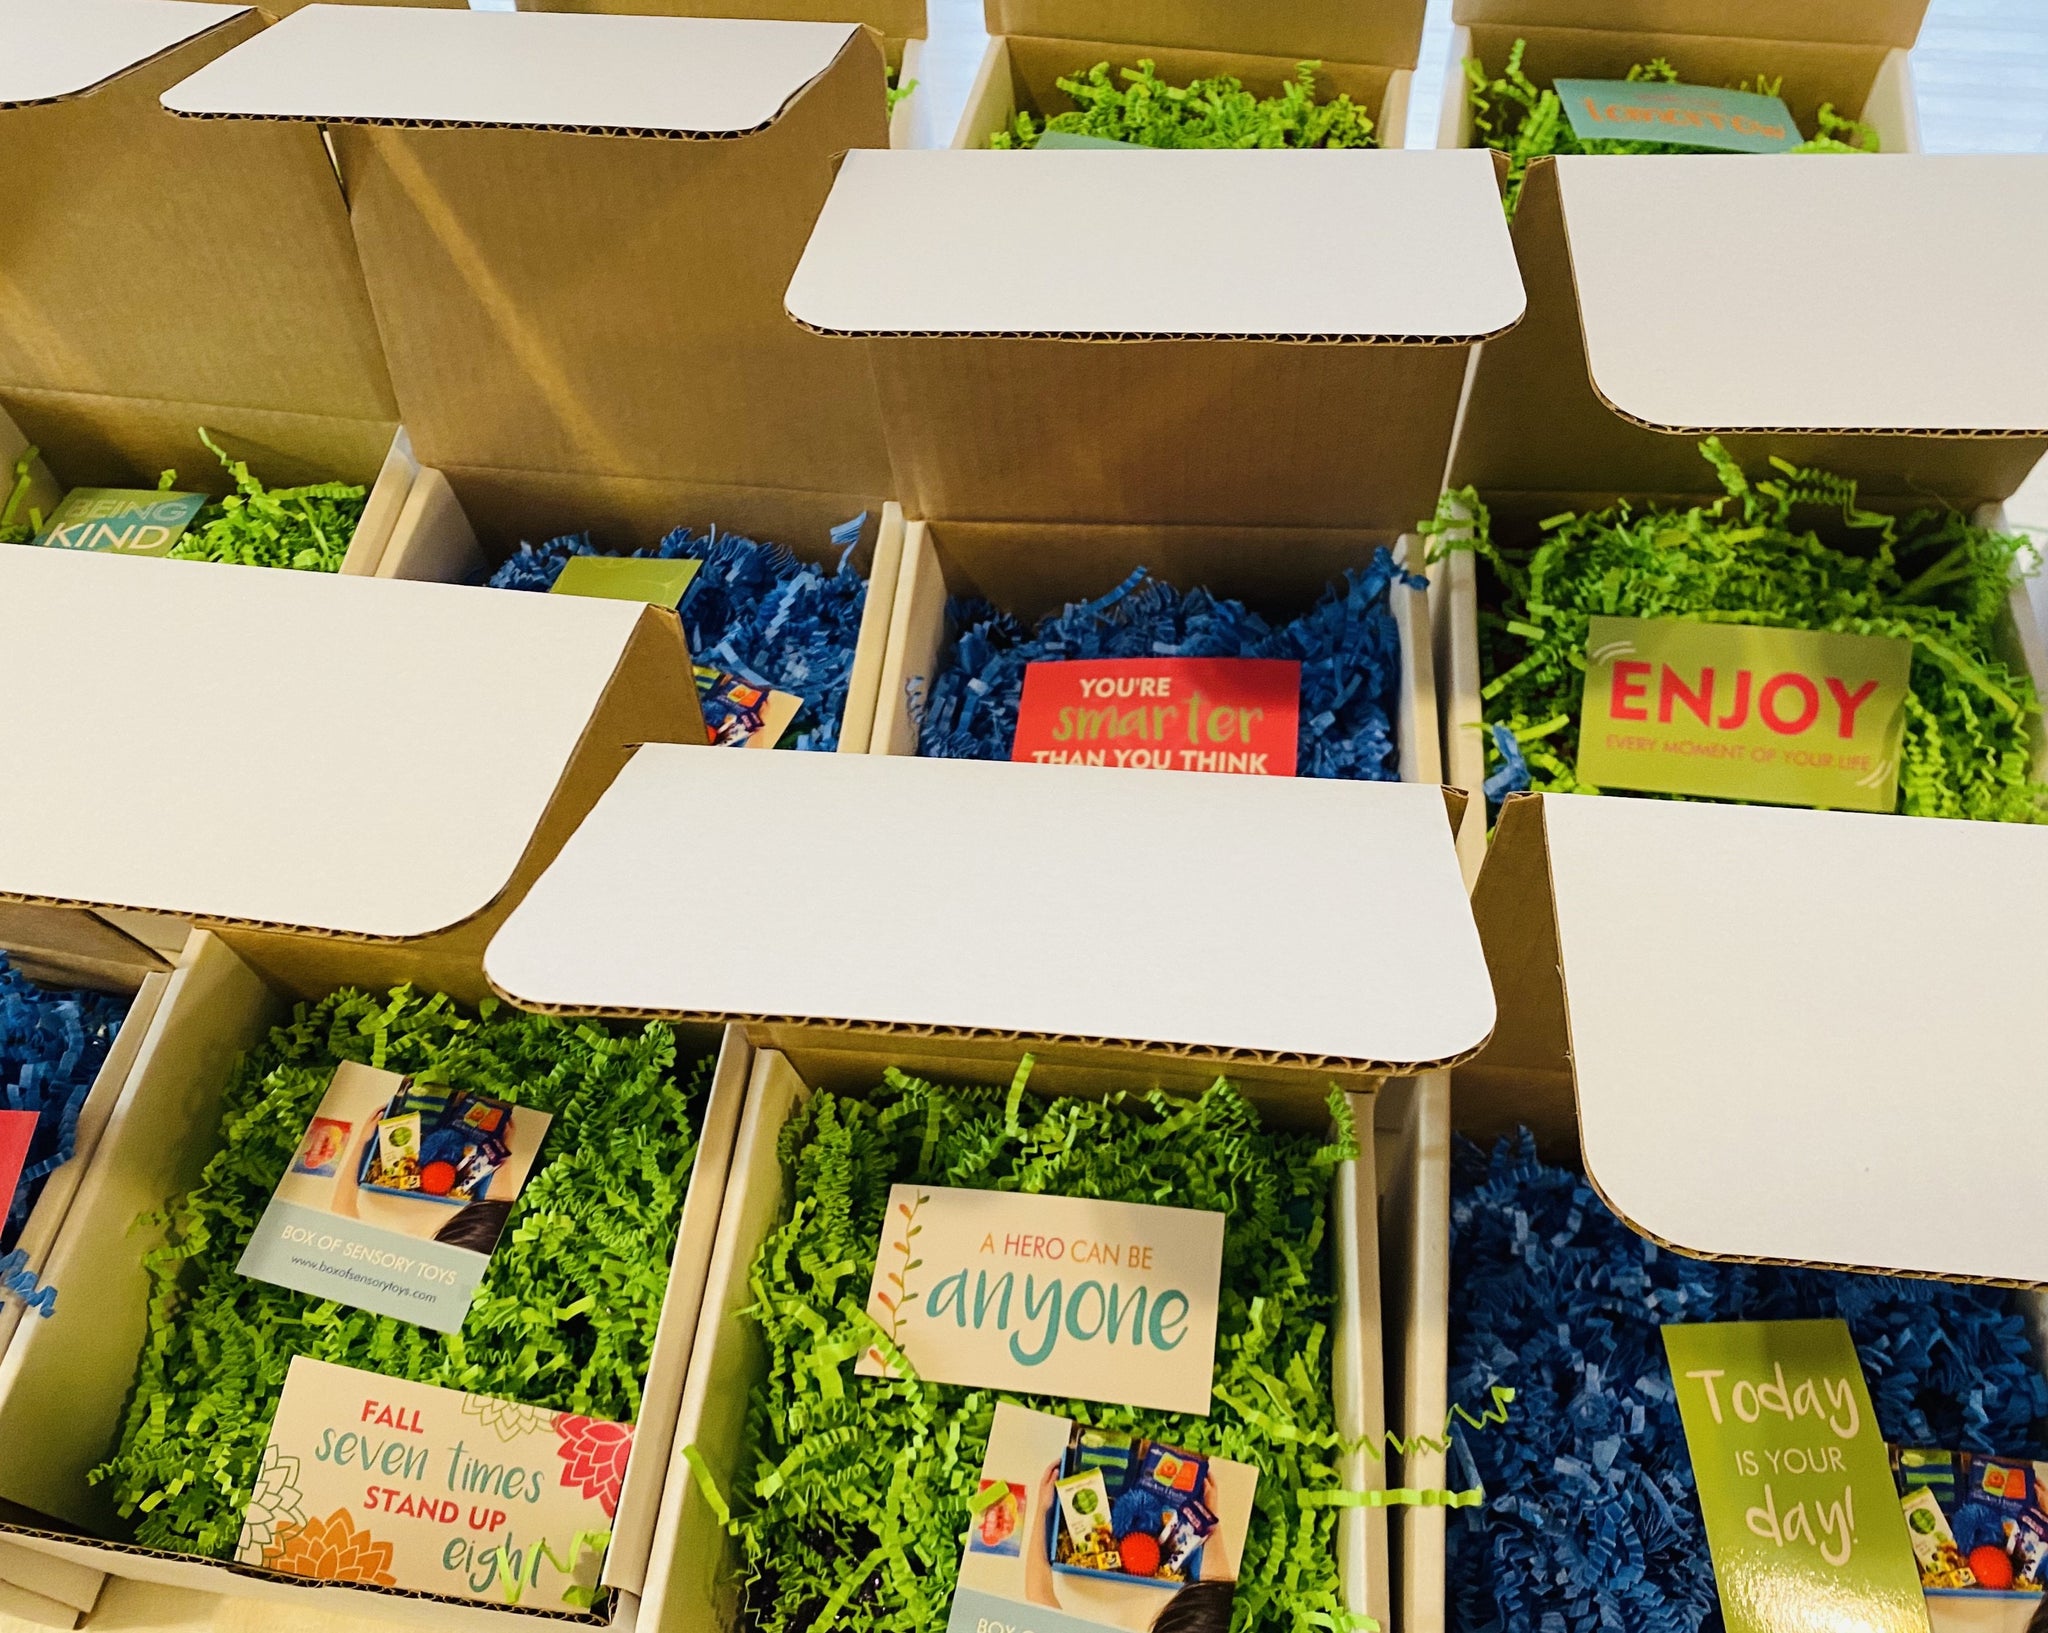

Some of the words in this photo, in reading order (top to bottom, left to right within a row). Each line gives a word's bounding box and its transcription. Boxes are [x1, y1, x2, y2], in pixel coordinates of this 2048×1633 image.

[65, 500, 188, 522] BEING
[44, 522, 171, 549] KIND
[1080, 677, 1172, 698] YOU'RE
[1609, 660, 1880, 739] ENJOY
[1052, 690, 1264, 744] smarter
[1031, 749, 1106, 767] THAN
[1113, 749, 1172, 770] YOU
[1179, 749, 1269, 775] THINK
[1605, 734, 1657, 752] EVERY
[1662, 740, 1747, 760] MOMENT
[1750, 746, 1777, 764] OF
[1783, 750, 1834, 768] YOUR
[1838, 754, 1872, 772] LIFE
[280, 1224, 315, 1246] BOX
[317, 1236, 343, 1253] OF
[343, 1243, 416, 1273] SENSORY
[418, 1262, 459, 1286] TOYS
[979, 1232, 995, 1255] A
[1003, 1233, 1066, 1260] HERO
[1070, 1239, 1121, 1266] CAN
[1128, 1245, 1154, 1270] BE
[290, 1254, 437, 1304] www.boxofsensorytoys.com
[925, 1268, 1190, 1367] anyone
[361, 1399, 424, 1434] FALL
[1685, 1361, 1861, 1440] Today
[315, 1427, 429, 1481] seven
[447, 1440, 545, 1504] times
[1735, 1450, 1759, 1477] IS
[1765, 1446, 1847, 1476] YOUR
[363, 1485, 460, 1524] STAND
[468, 1506, 508, 1532] UP
[1745, 1483, 1859, 1568] day!
